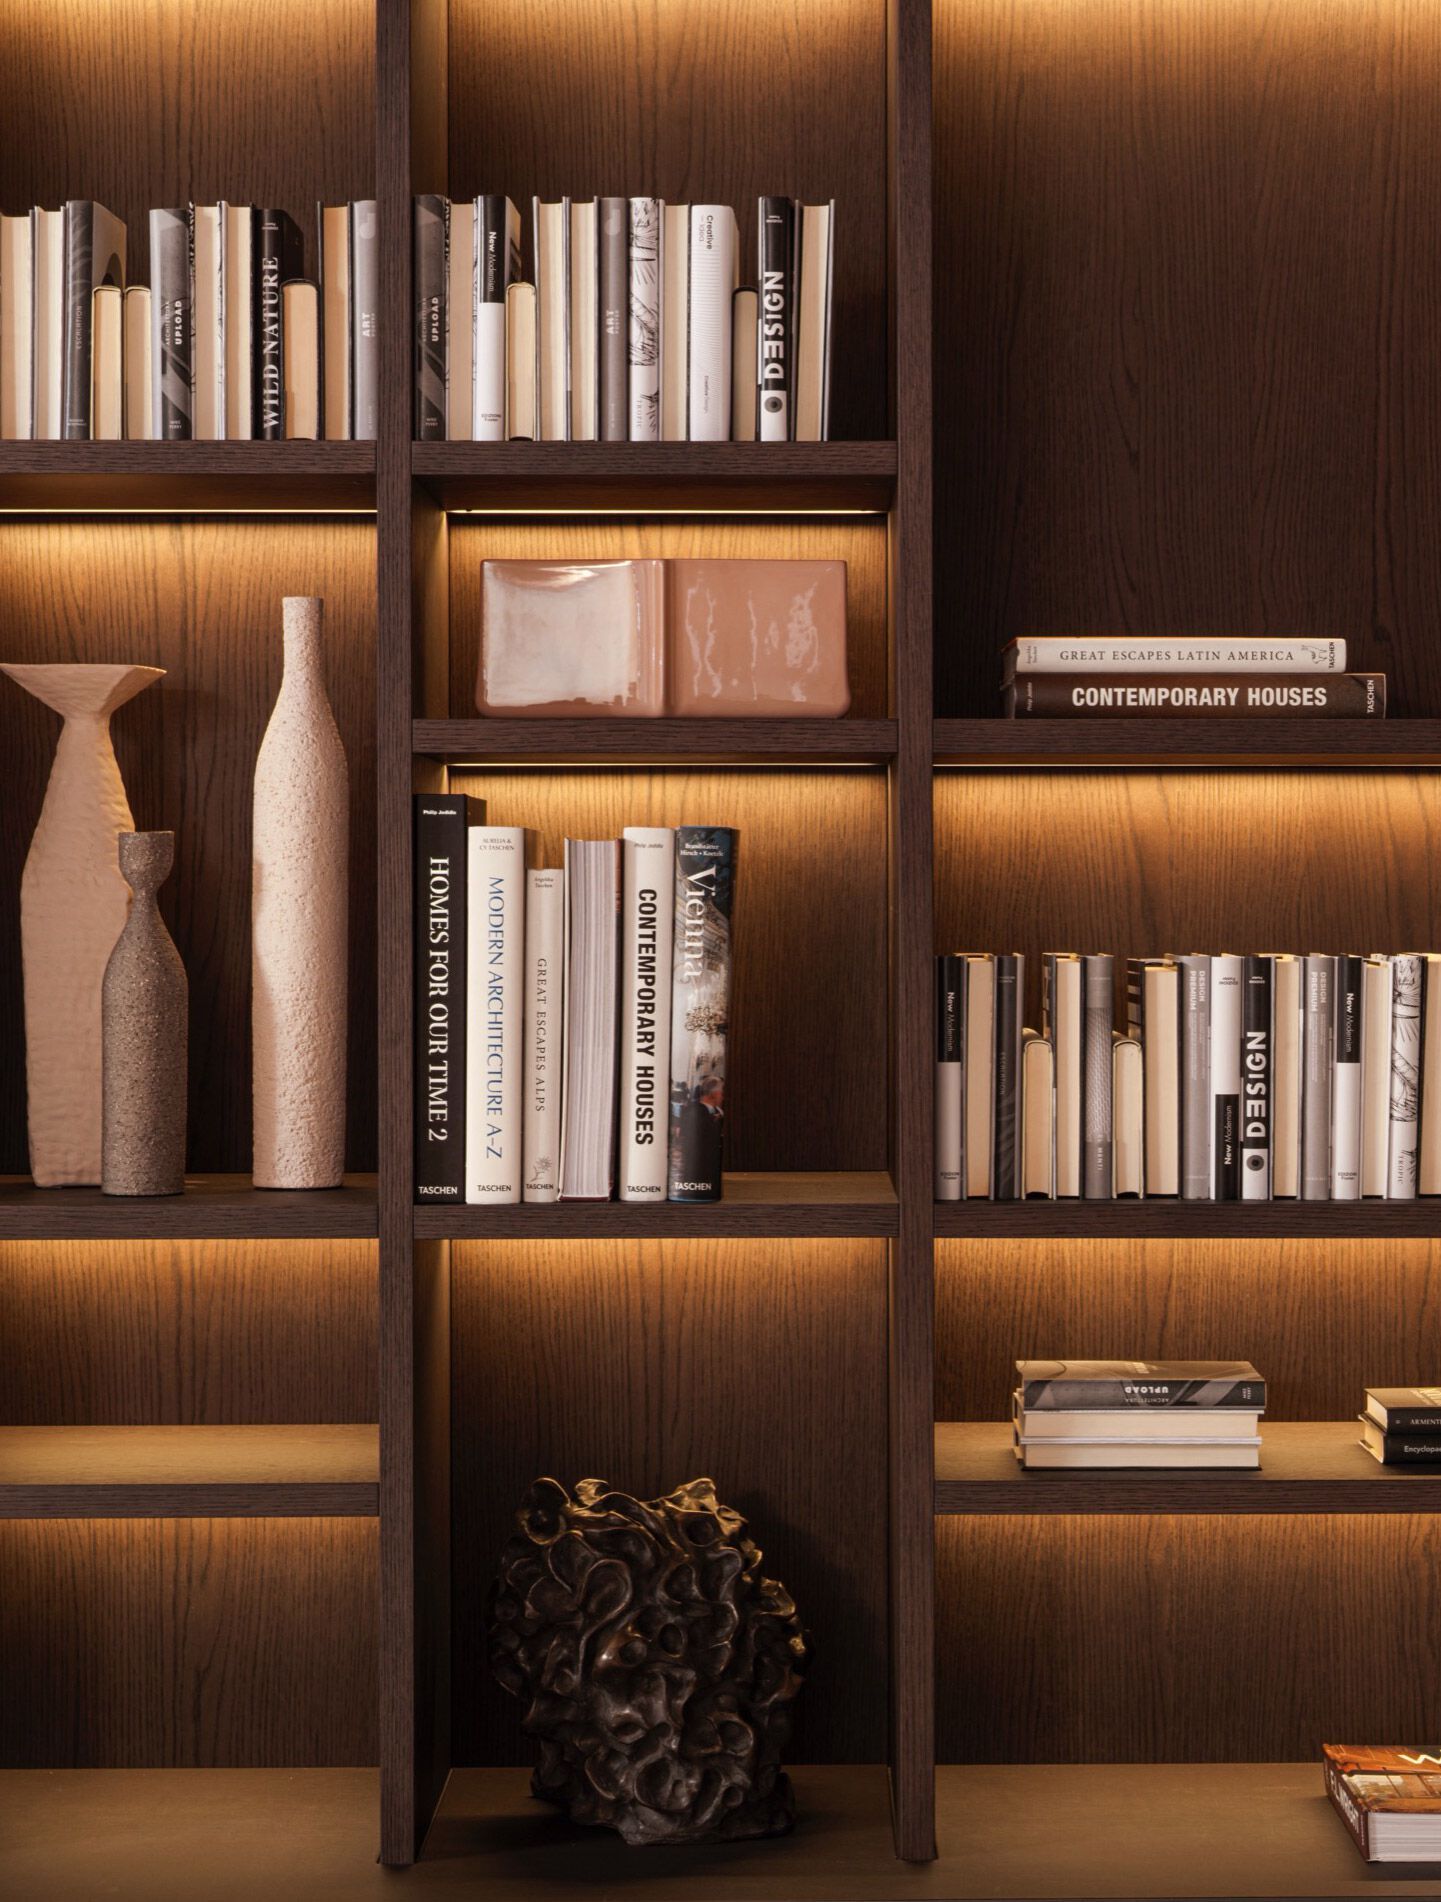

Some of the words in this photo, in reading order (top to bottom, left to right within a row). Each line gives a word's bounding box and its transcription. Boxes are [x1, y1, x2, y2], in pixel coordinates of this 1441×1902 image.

[488, 231, 497, 252] New
[488, 252, 497, 292] Modernism
[174, 300, 183, 345] UPLOAD
[262, 256, 280, 355] NATURE
[362, 312, 370, 337] ART
[606, 310, 614, 334] ART
[764, 271, 784, 379] DESIGN
[263, 364, 279, 428] WILD
[1060, 650, 1106, 660] GREAT
[1112, 650, 1171, 660] ESCAPES
[1178, 651, 1220, 660] LATIN
[1228, 650, 1294, 661] AMERICA
[1072, 687, 1240, 707] CONTEMPORARY
[1248, 687, 1327, 707] HOUSES
[1366, 679, 1374, 714] TASCHEN
[429, 857, 450, 944] HOMES
[488, 877, 504, 965] MODERN
[684, 865, 716, 977] Vienna
[428, 950, 449, 998] FOR
[537, 958, 547, 1004] GREAT
[636, 888, 658, 1057] CONTEMPORARY
[1311, 972, 1319, 1012] PREMIUM
[947, 992, 955, 1012] New
[1346, 992, 1354, 1013] New
[428, 1003, 448, 1054] OUR
[486, 971, 504, 1116] ARCHITECTURE
[536, 1011, 546, 1071] ESCAPES
[948, 1012, 956, 1052] Modernism
[1346, 1015, 1355, 1053] Modernism
[428, 1060, 448, 1122] TIME
[536, 1078, 545, 1112] ALPS
[1246, 1032, 1267, 1138] DESIGN
[635, 1066, 654, 1145] HOUSES
[1224, 1106, 1232, 1142] Modernism
[428, 1130, 448, 1142] 2
[1224, 1146, 1232, 1165] New
[418, 1186, 458, 1195] TASCHEN
[674, 1182, 712, 1190] TASCHEN
